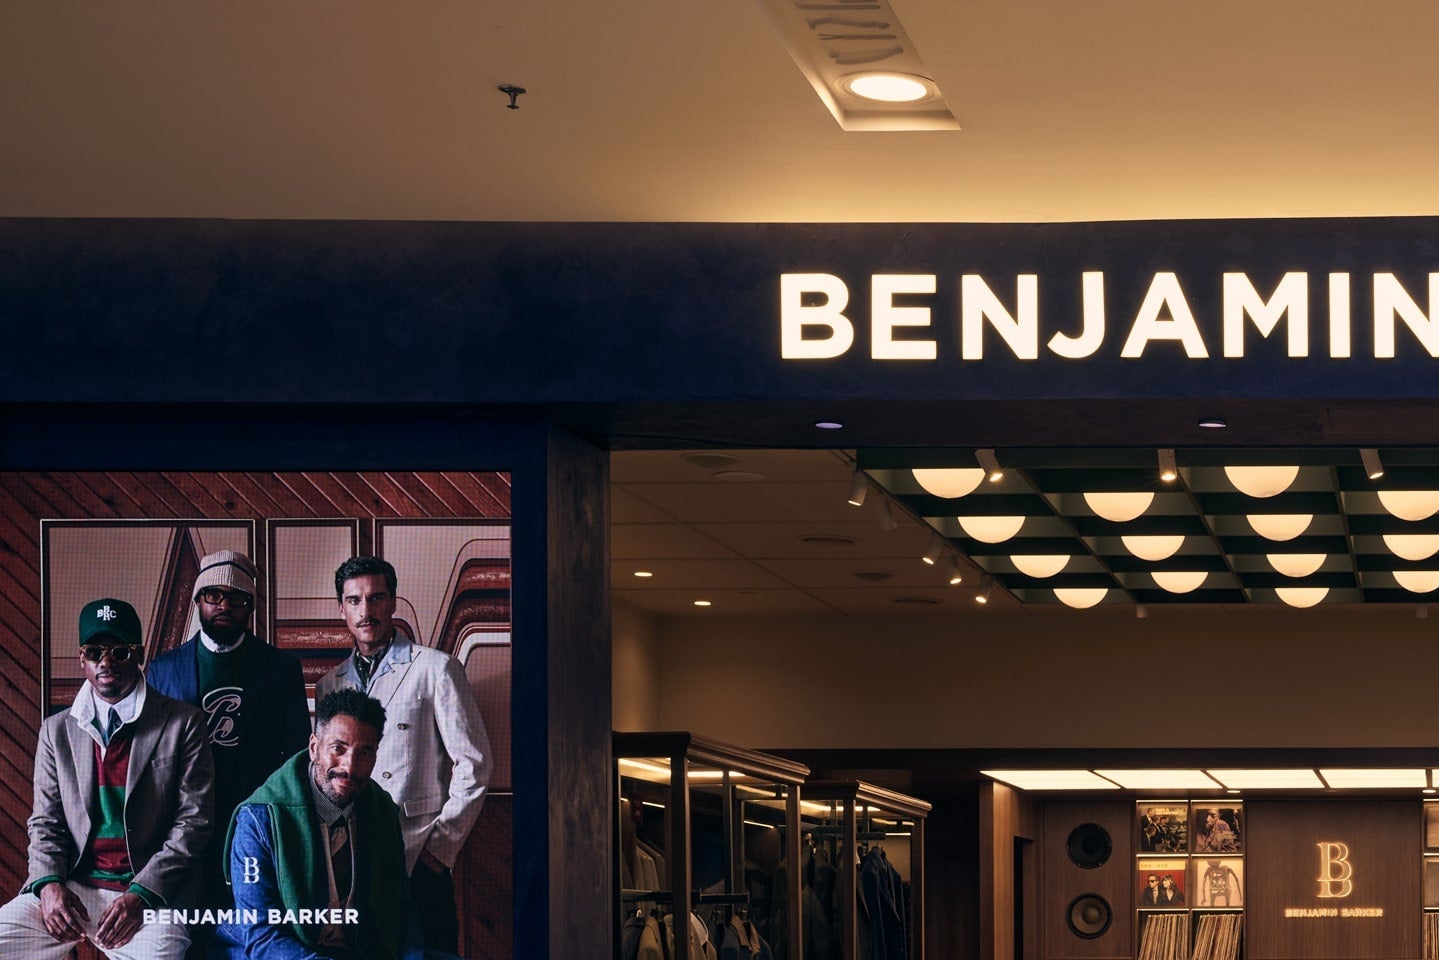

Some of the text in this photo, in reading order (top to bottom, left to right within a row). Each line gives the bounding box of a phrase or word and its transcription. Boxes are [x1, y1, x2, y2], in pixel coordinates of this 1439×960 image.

[143, 909, 359, 925] BENJAMIN BARKER
[1285, 907, 1383, 918] BENJAMIN BARKER
